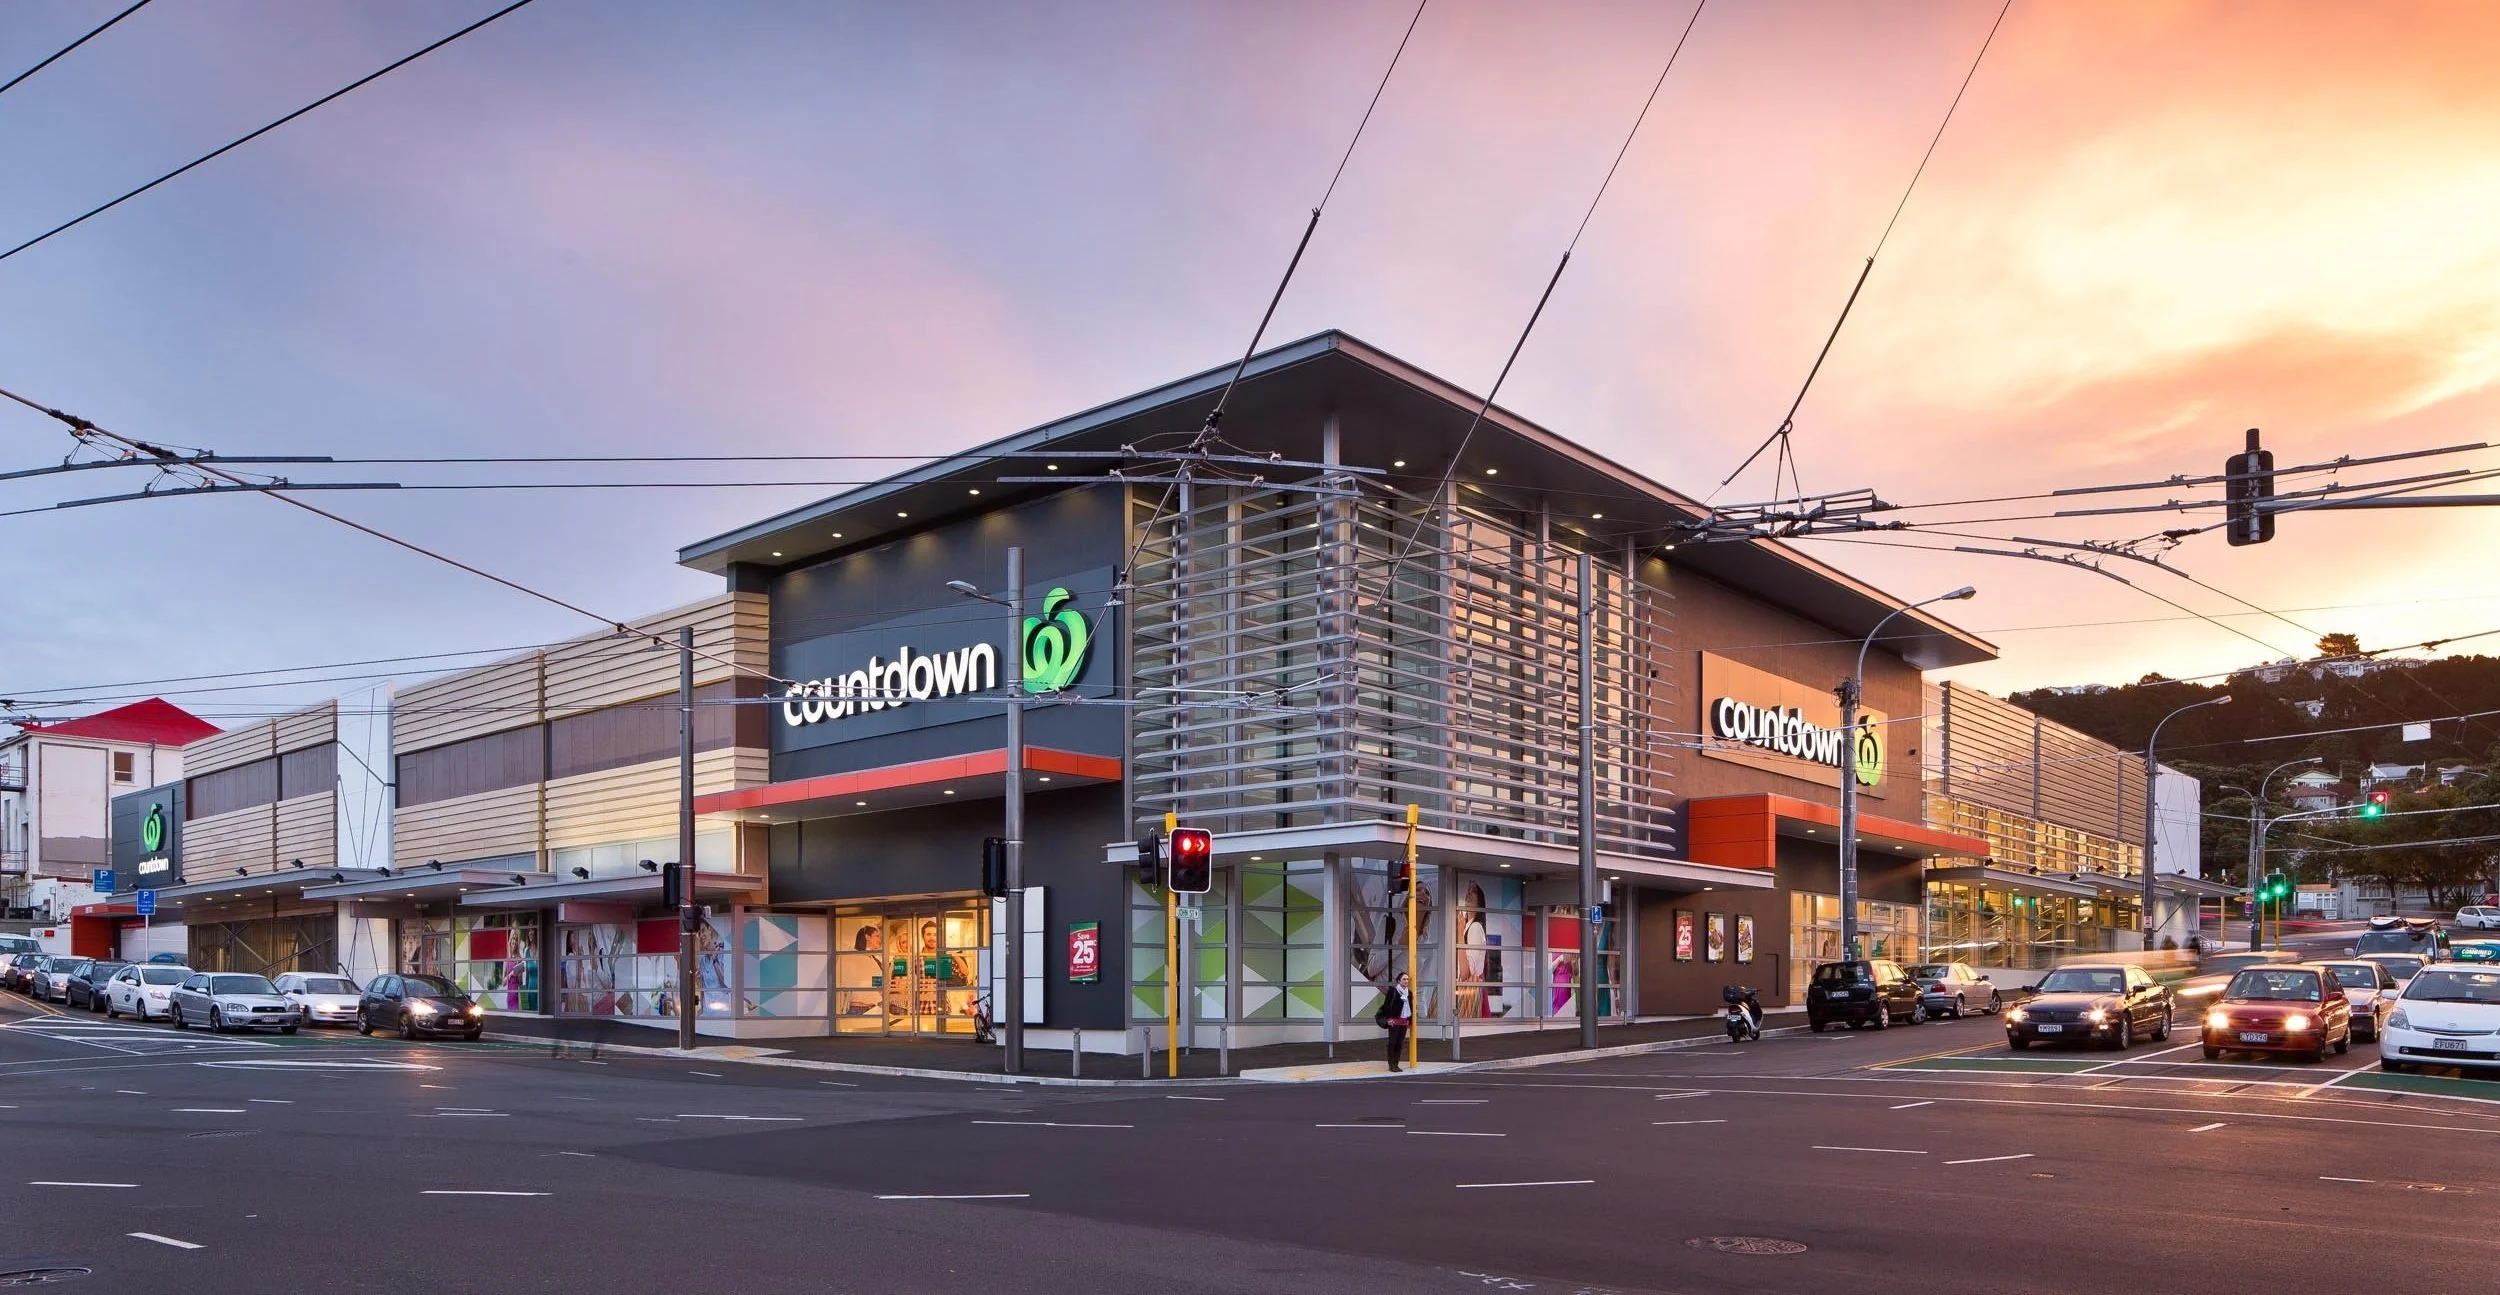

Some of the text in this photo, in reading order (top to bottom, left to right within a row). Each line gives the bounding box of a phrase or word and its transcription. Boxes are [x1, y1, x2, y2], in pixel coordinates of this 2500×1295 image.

[784, 643, 995, 726] countdown
[1718, 697, 1843, 767] countdown
[100, 871, 108, 879] P
[138, 856, 169, 875] countdown
[143, 891, 150, 899] P
[1678, 926, 1692, 946] 25
[2434, 1040, 2465, 1050] EFU671
